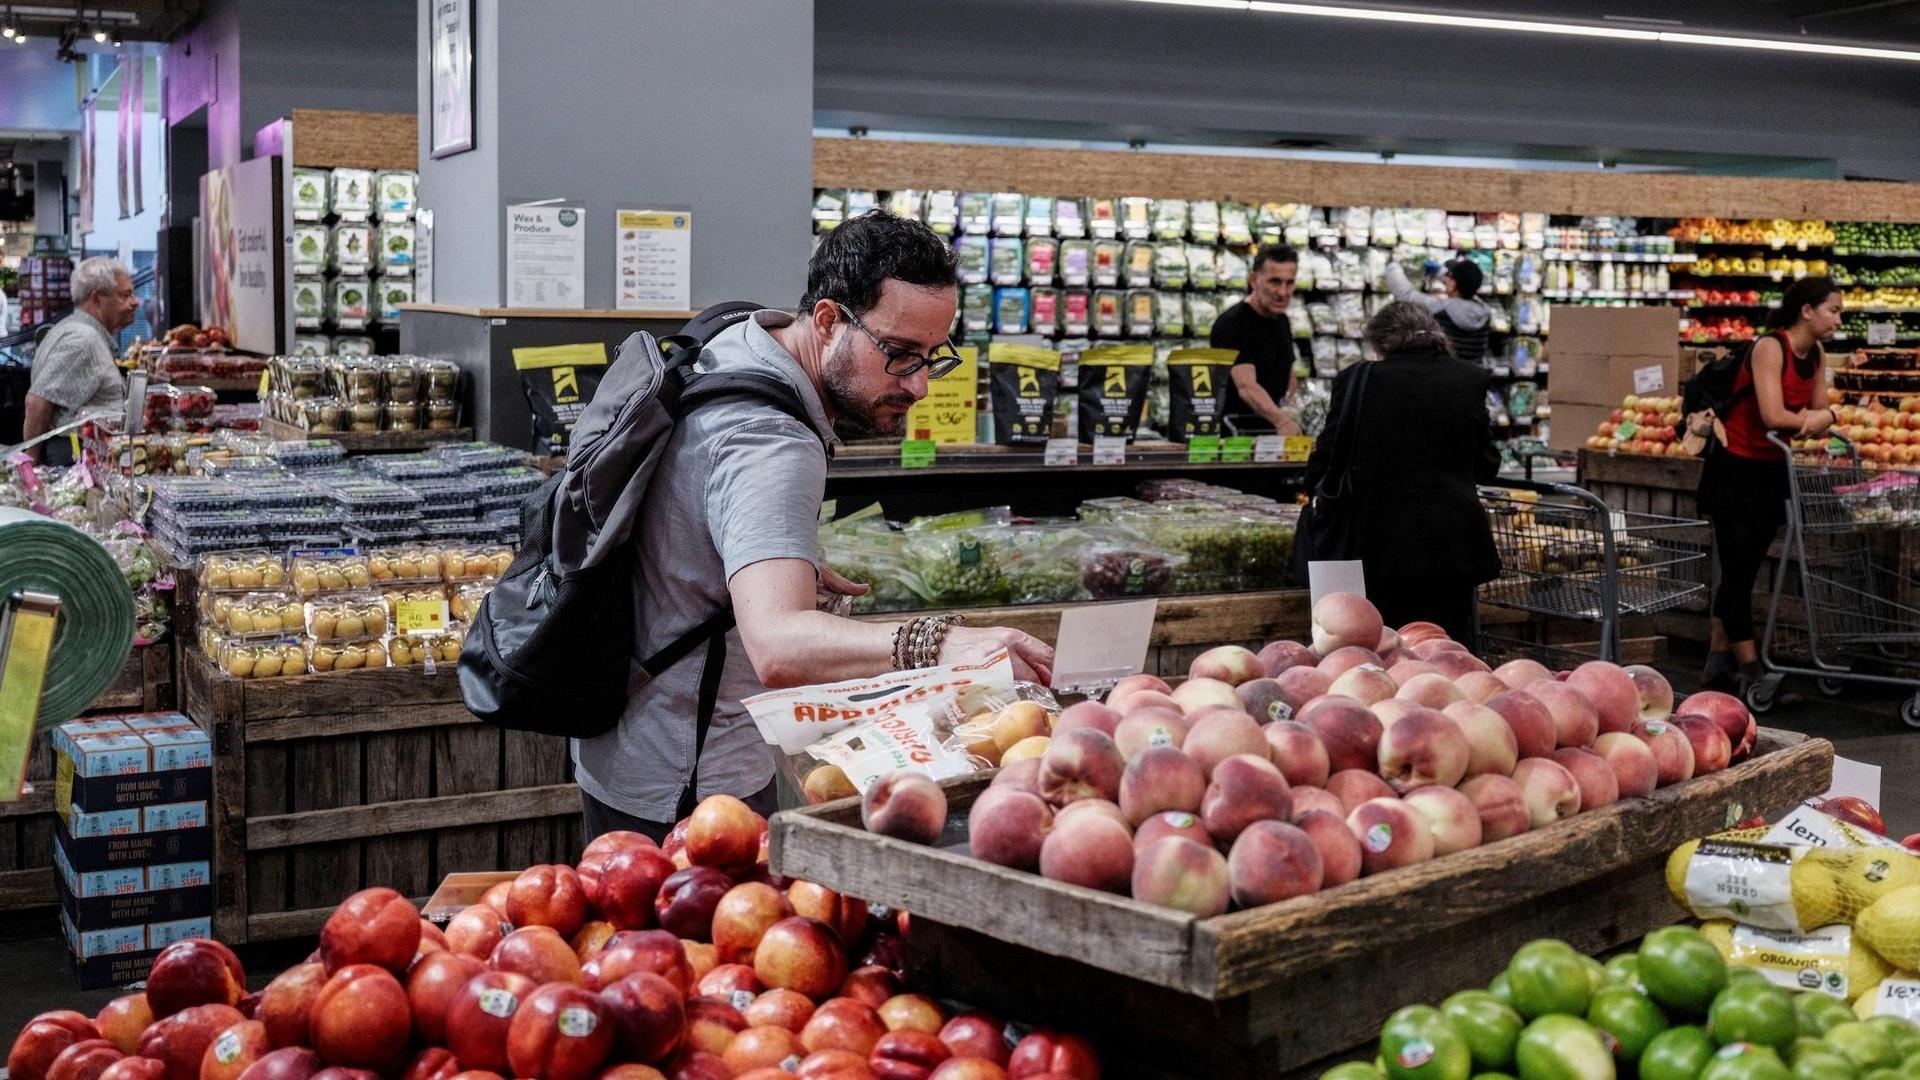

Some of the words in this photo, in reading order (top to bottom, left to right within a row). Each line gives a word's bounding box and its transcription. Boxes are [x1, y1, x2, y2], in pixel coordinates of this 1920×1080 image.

[513, 213, 533, 223] Wax
[536, 214, 543, 223] &
[513, 223, 551, 233] Produce
[116, 782, 136, 793] FROM
[116, 793, 135, 803] WITH
[1786, 818, 1827, 848] lem
[108, 840, 129, 850] FROM
[108, 851, 127, 860] WITH
[1716, 883, 1758, 898] GREEN
[1760, 952, 1819, 969] ORGANIC
[112, 961, 132, 971] FROM
[112, 972, 131, 981] WITH
